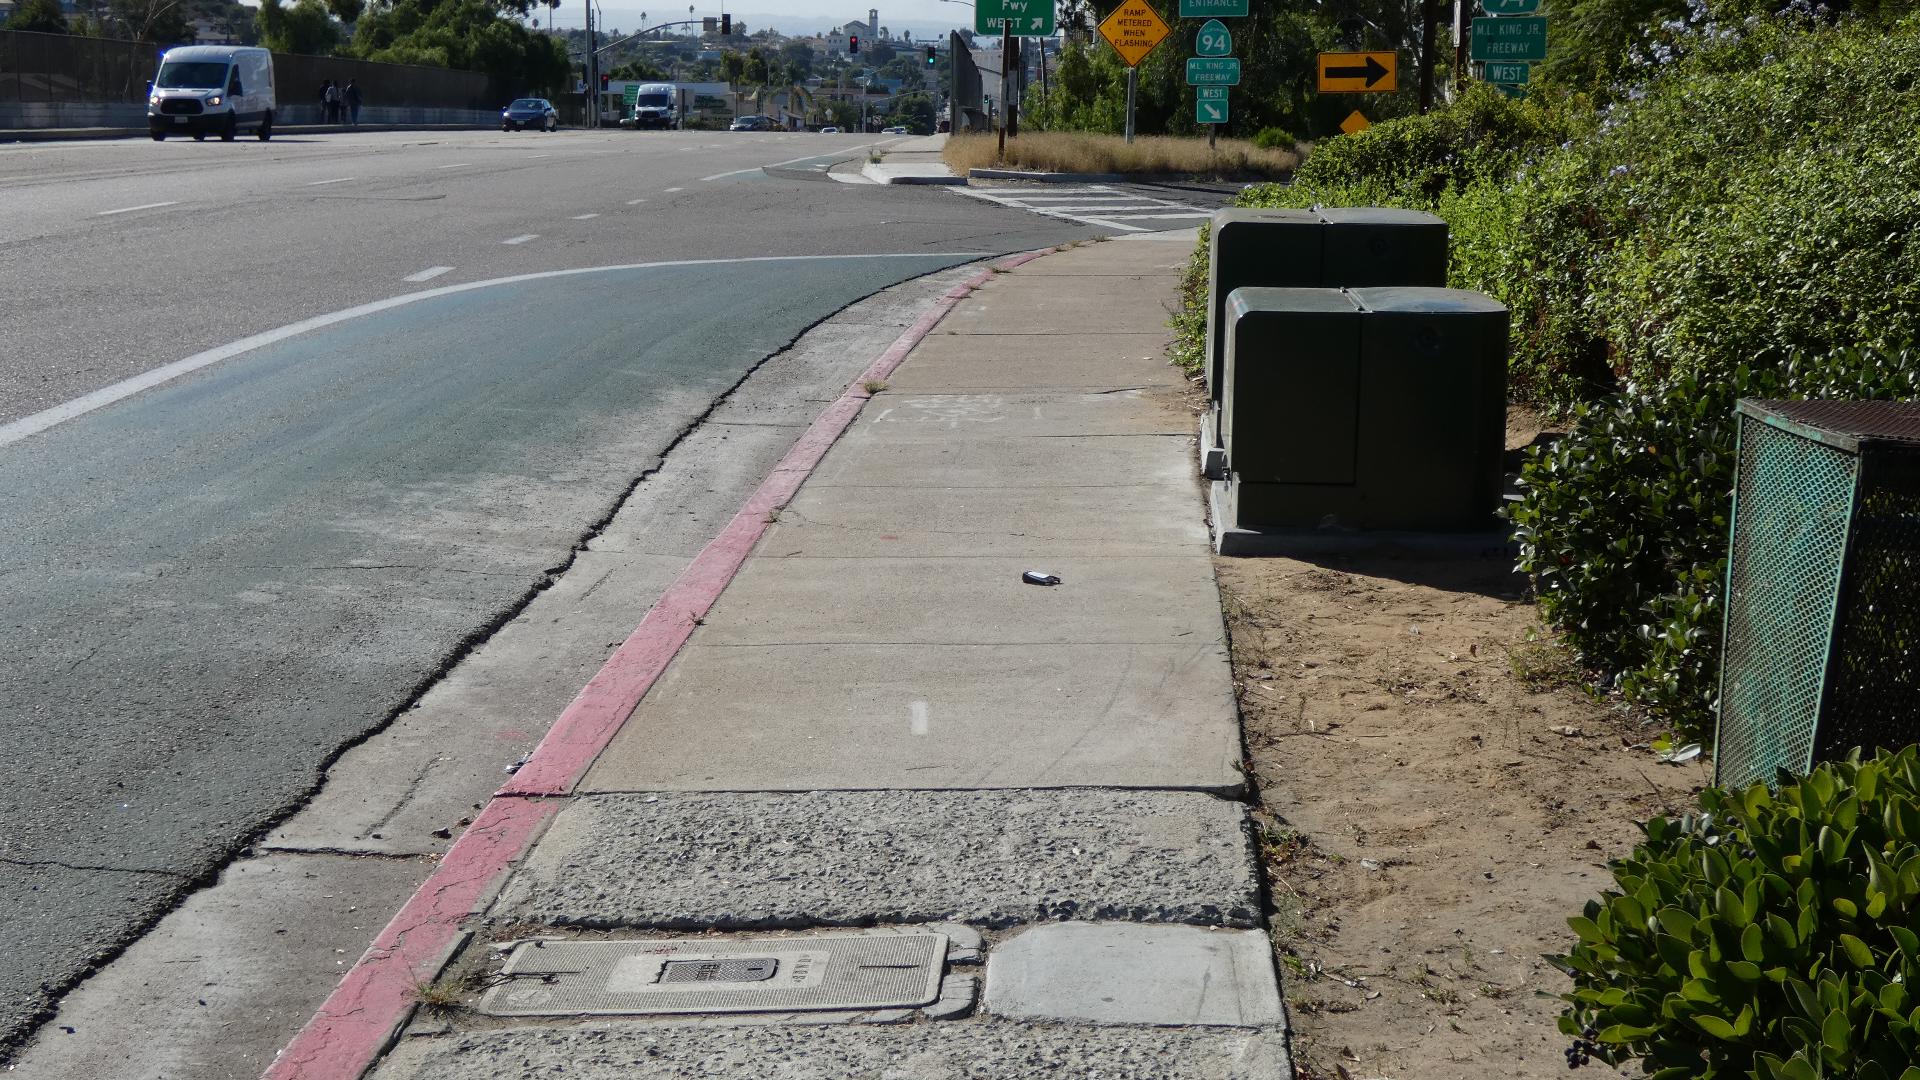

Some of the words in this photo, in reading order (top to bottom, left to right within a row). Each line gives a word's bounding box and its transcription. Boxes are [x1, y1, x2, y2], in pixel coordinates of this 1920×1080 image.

[1117, 19, 1152, 27] METERED
[1123, 29, 1146, 37] WHEN
[1499, 24, 1522, 35] KING
[1114, 40, 1153, 48] FLASHING
[1202, 35, 1226, 51] 94
[1486, 42, 1530, 54] FREEWAY
[1206, 62, 1224, 70] KING
[1195, 73, 1231, 81] FREEWAY
[1492, 65, 1521, 81] WEST
[1202, 89, 1223, 98] WEST
